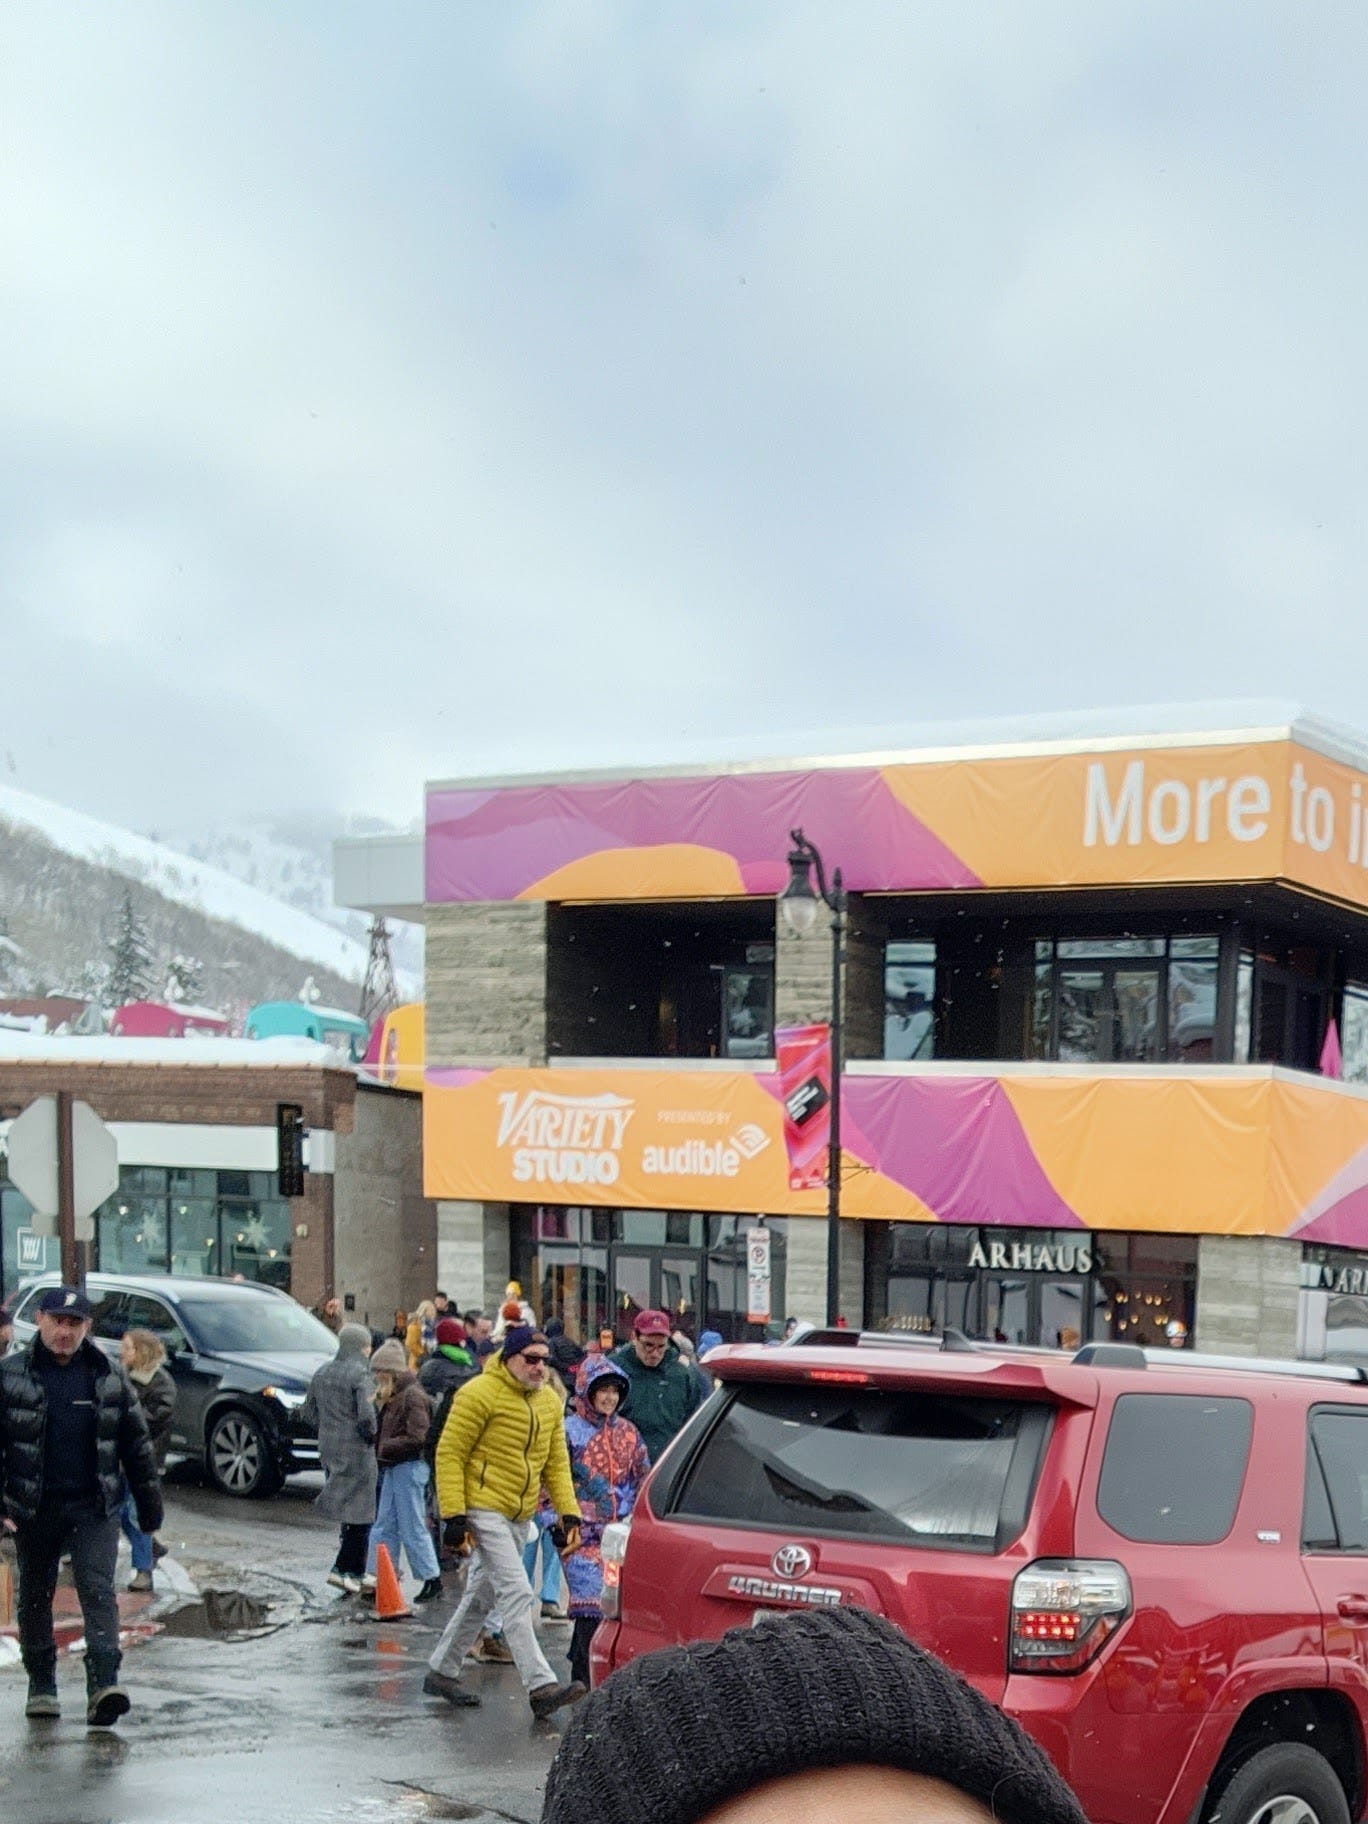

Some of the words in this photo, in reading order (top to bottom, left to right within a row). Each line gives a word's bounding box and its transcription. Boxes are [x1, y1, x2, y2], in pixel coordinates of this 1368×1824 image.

[1083, 760, 1271, 847] More
[1290, 762, 1335, 852] to
[496, 1090, 636, 1150] VARIETY
[512, 1148, 619, 1184] STUDIO
[642, 1140, 740, 1177] audible
[967, 1241, 1093, 1274] ARHAUS
[728, 1575, 842, 1605] 4RUNNER
